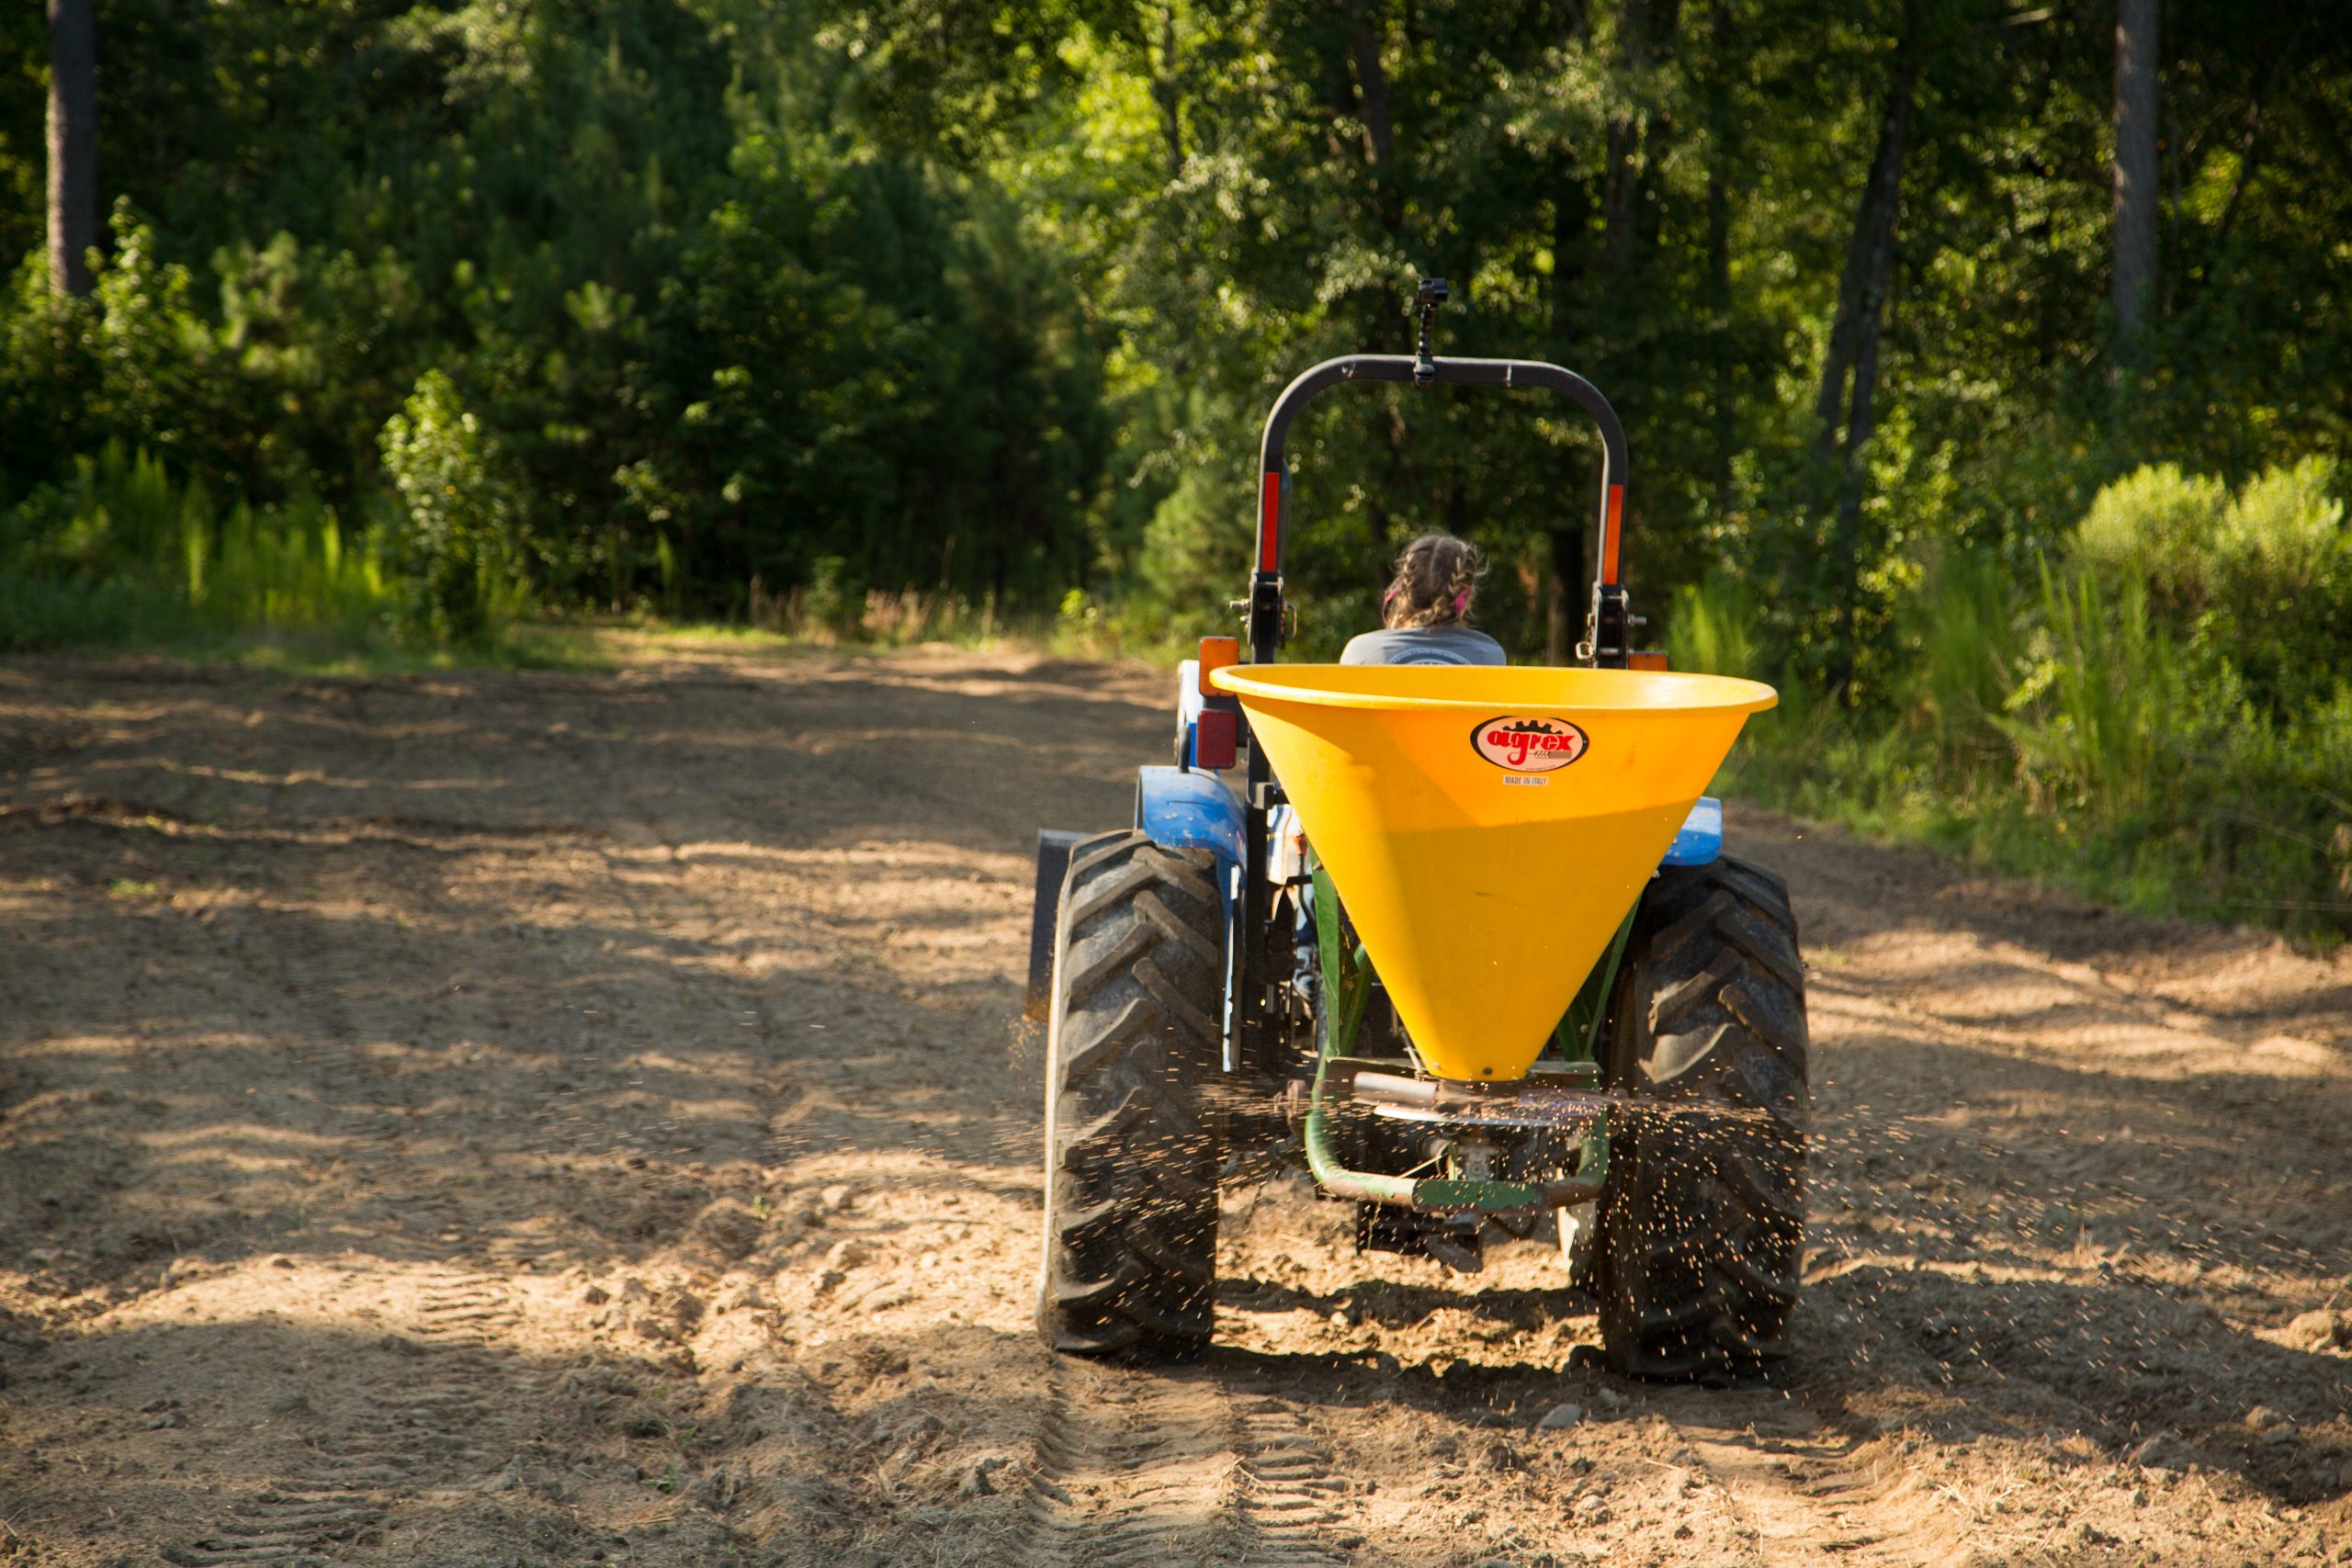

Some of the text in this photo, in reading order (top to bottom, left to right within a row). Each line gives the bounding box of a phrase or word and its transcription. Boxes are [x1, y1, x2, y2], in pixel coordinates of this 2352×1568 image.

[1487, 730, 1575, 765] agrex
[1504, 775, 1547, 785] MADE IN ITALY
